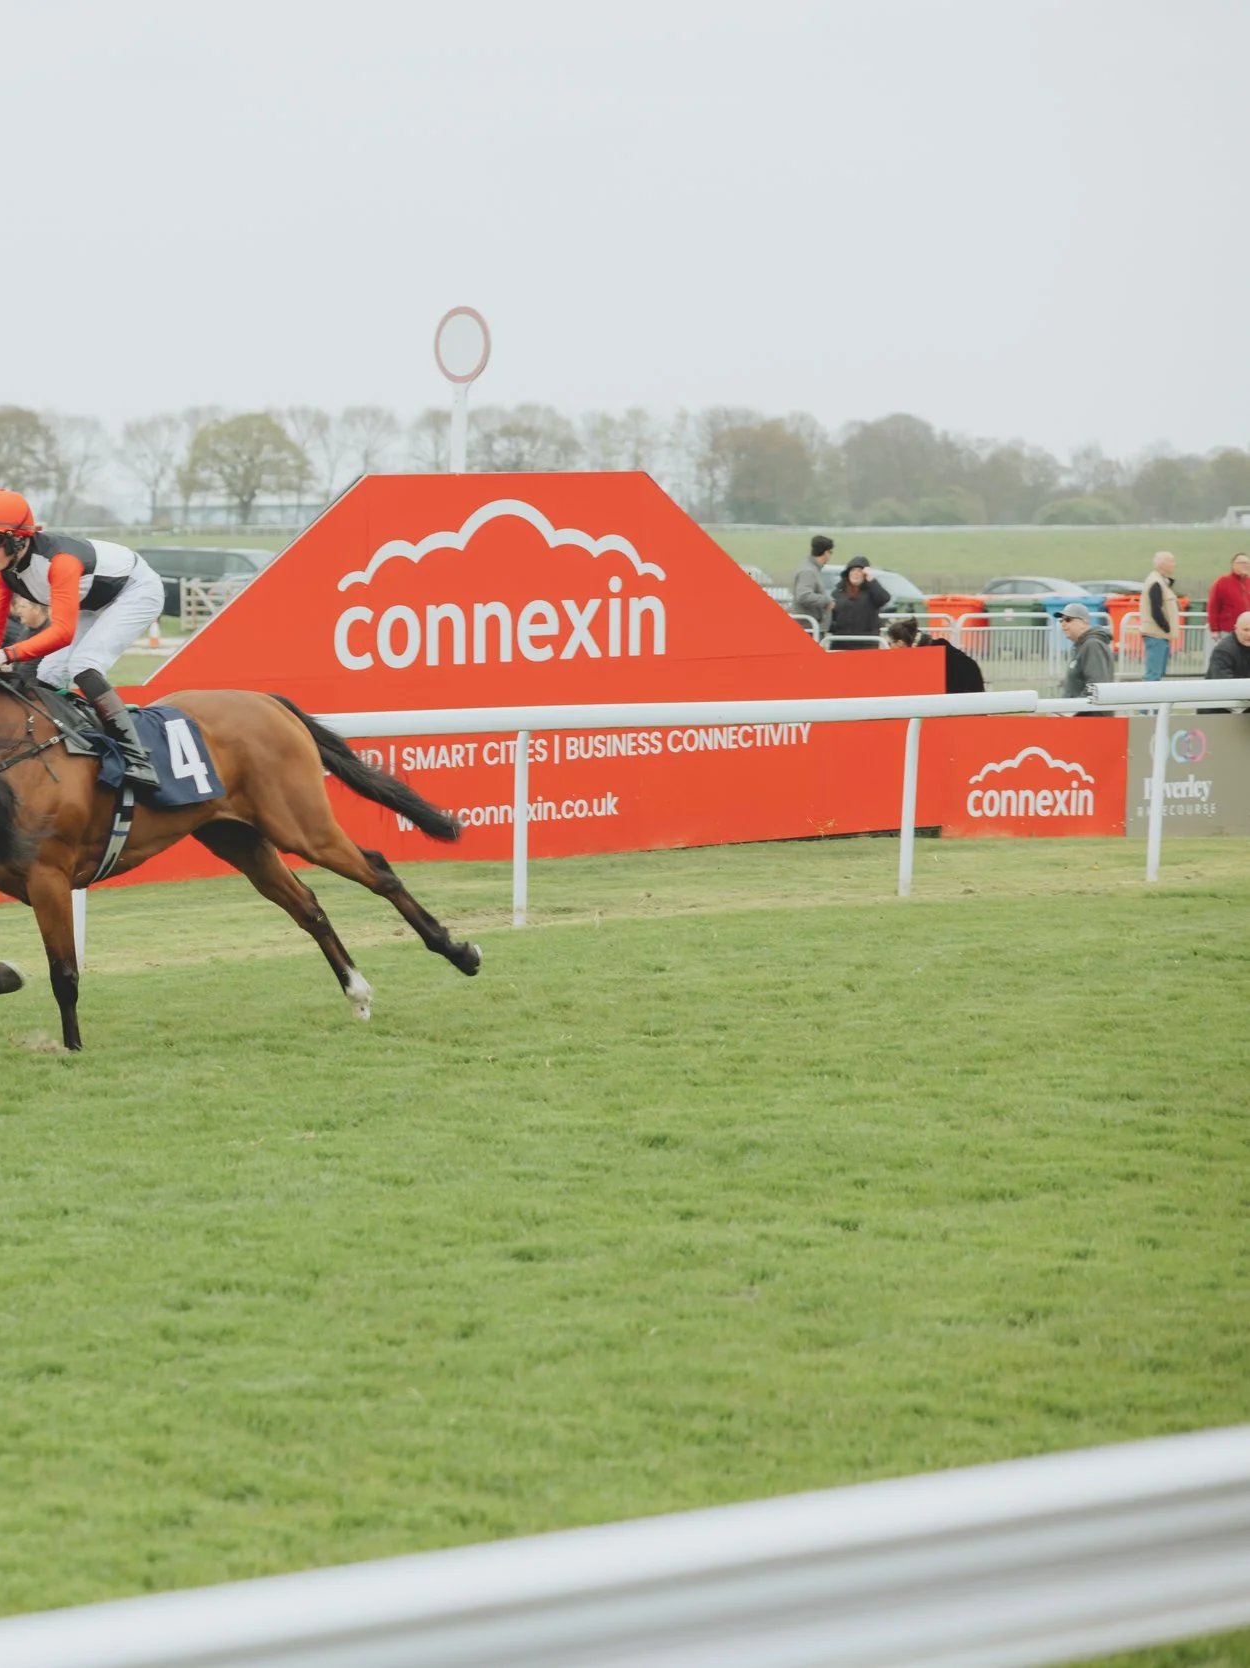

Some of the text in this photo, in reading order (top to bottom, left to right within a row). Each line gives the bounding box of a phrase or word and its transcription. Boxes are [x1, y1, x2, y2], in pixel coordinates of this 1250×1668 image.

[333, 575, 666, 670] connexin
[164, 718, 212, 794] 4
[402, 743, 478, 771] SMART
[482, 738, 548, 766] CITES
[565, 731, 662, 760] BUSINESS
[667, 722, 811, 753] CONNECTIVITY
[967, 780, 1094, 817] connexin
[1143, 774, 1212, 802] Bverley
[396, 792, 619, 832] wconnxin.co.uk
[1137, 803, 1216, 818] RECOURSE
